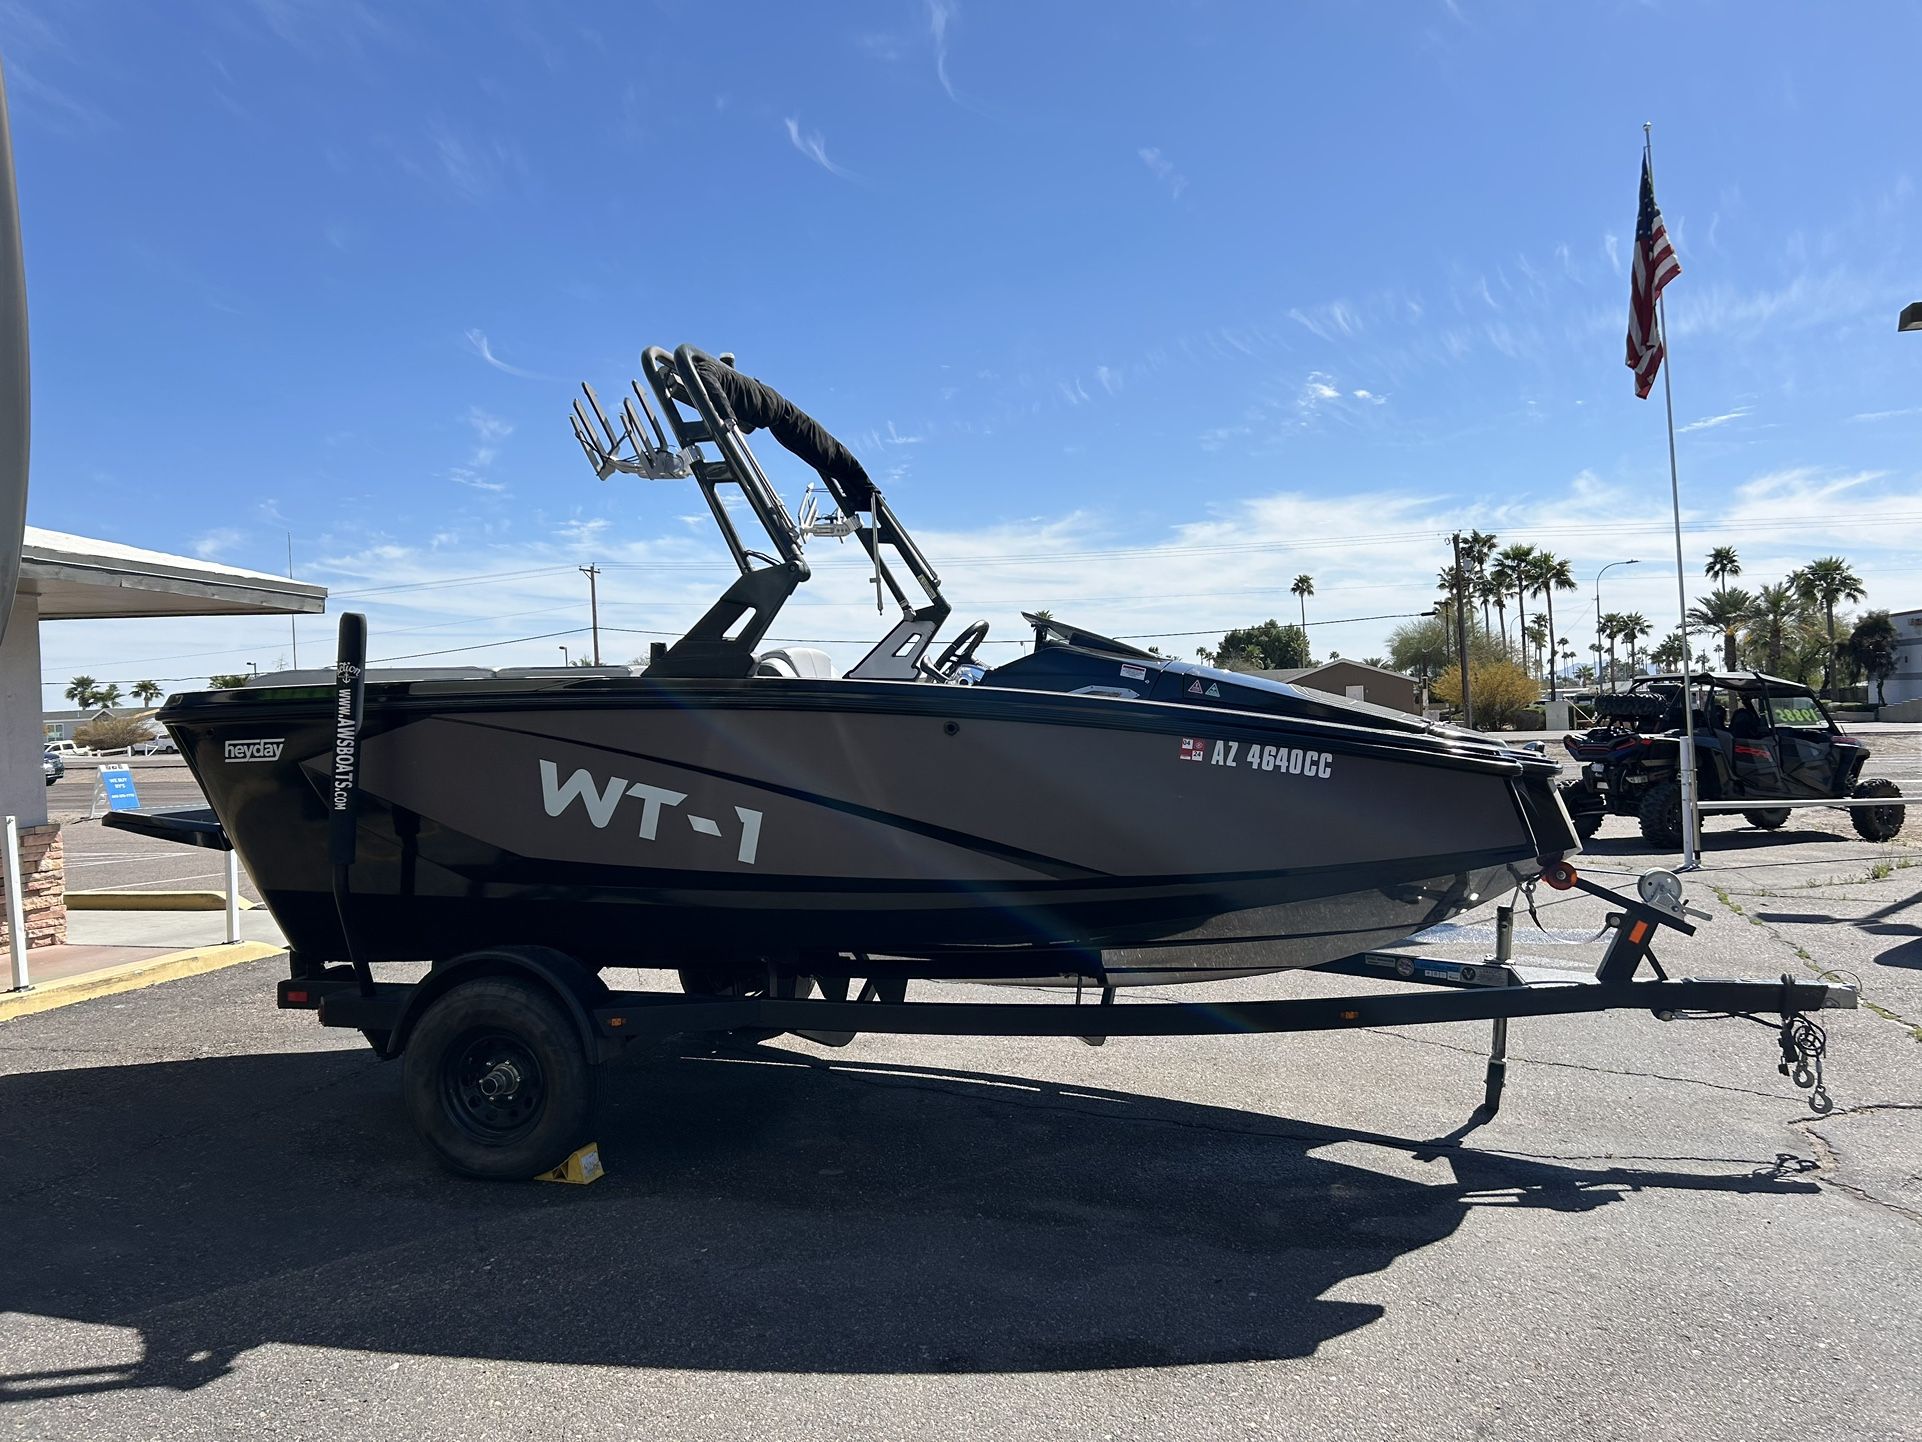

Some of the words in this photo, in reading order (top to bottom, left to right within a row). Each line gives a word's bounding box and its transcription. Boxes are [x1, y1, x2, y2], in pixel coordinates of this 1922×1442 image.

[225, 738, 285, 762] heyday
[1210, 740, 1239, 767] AZ
[1247, 744, 1333, 779] 4640CC
[539, 759, 763, 864] WT-1
